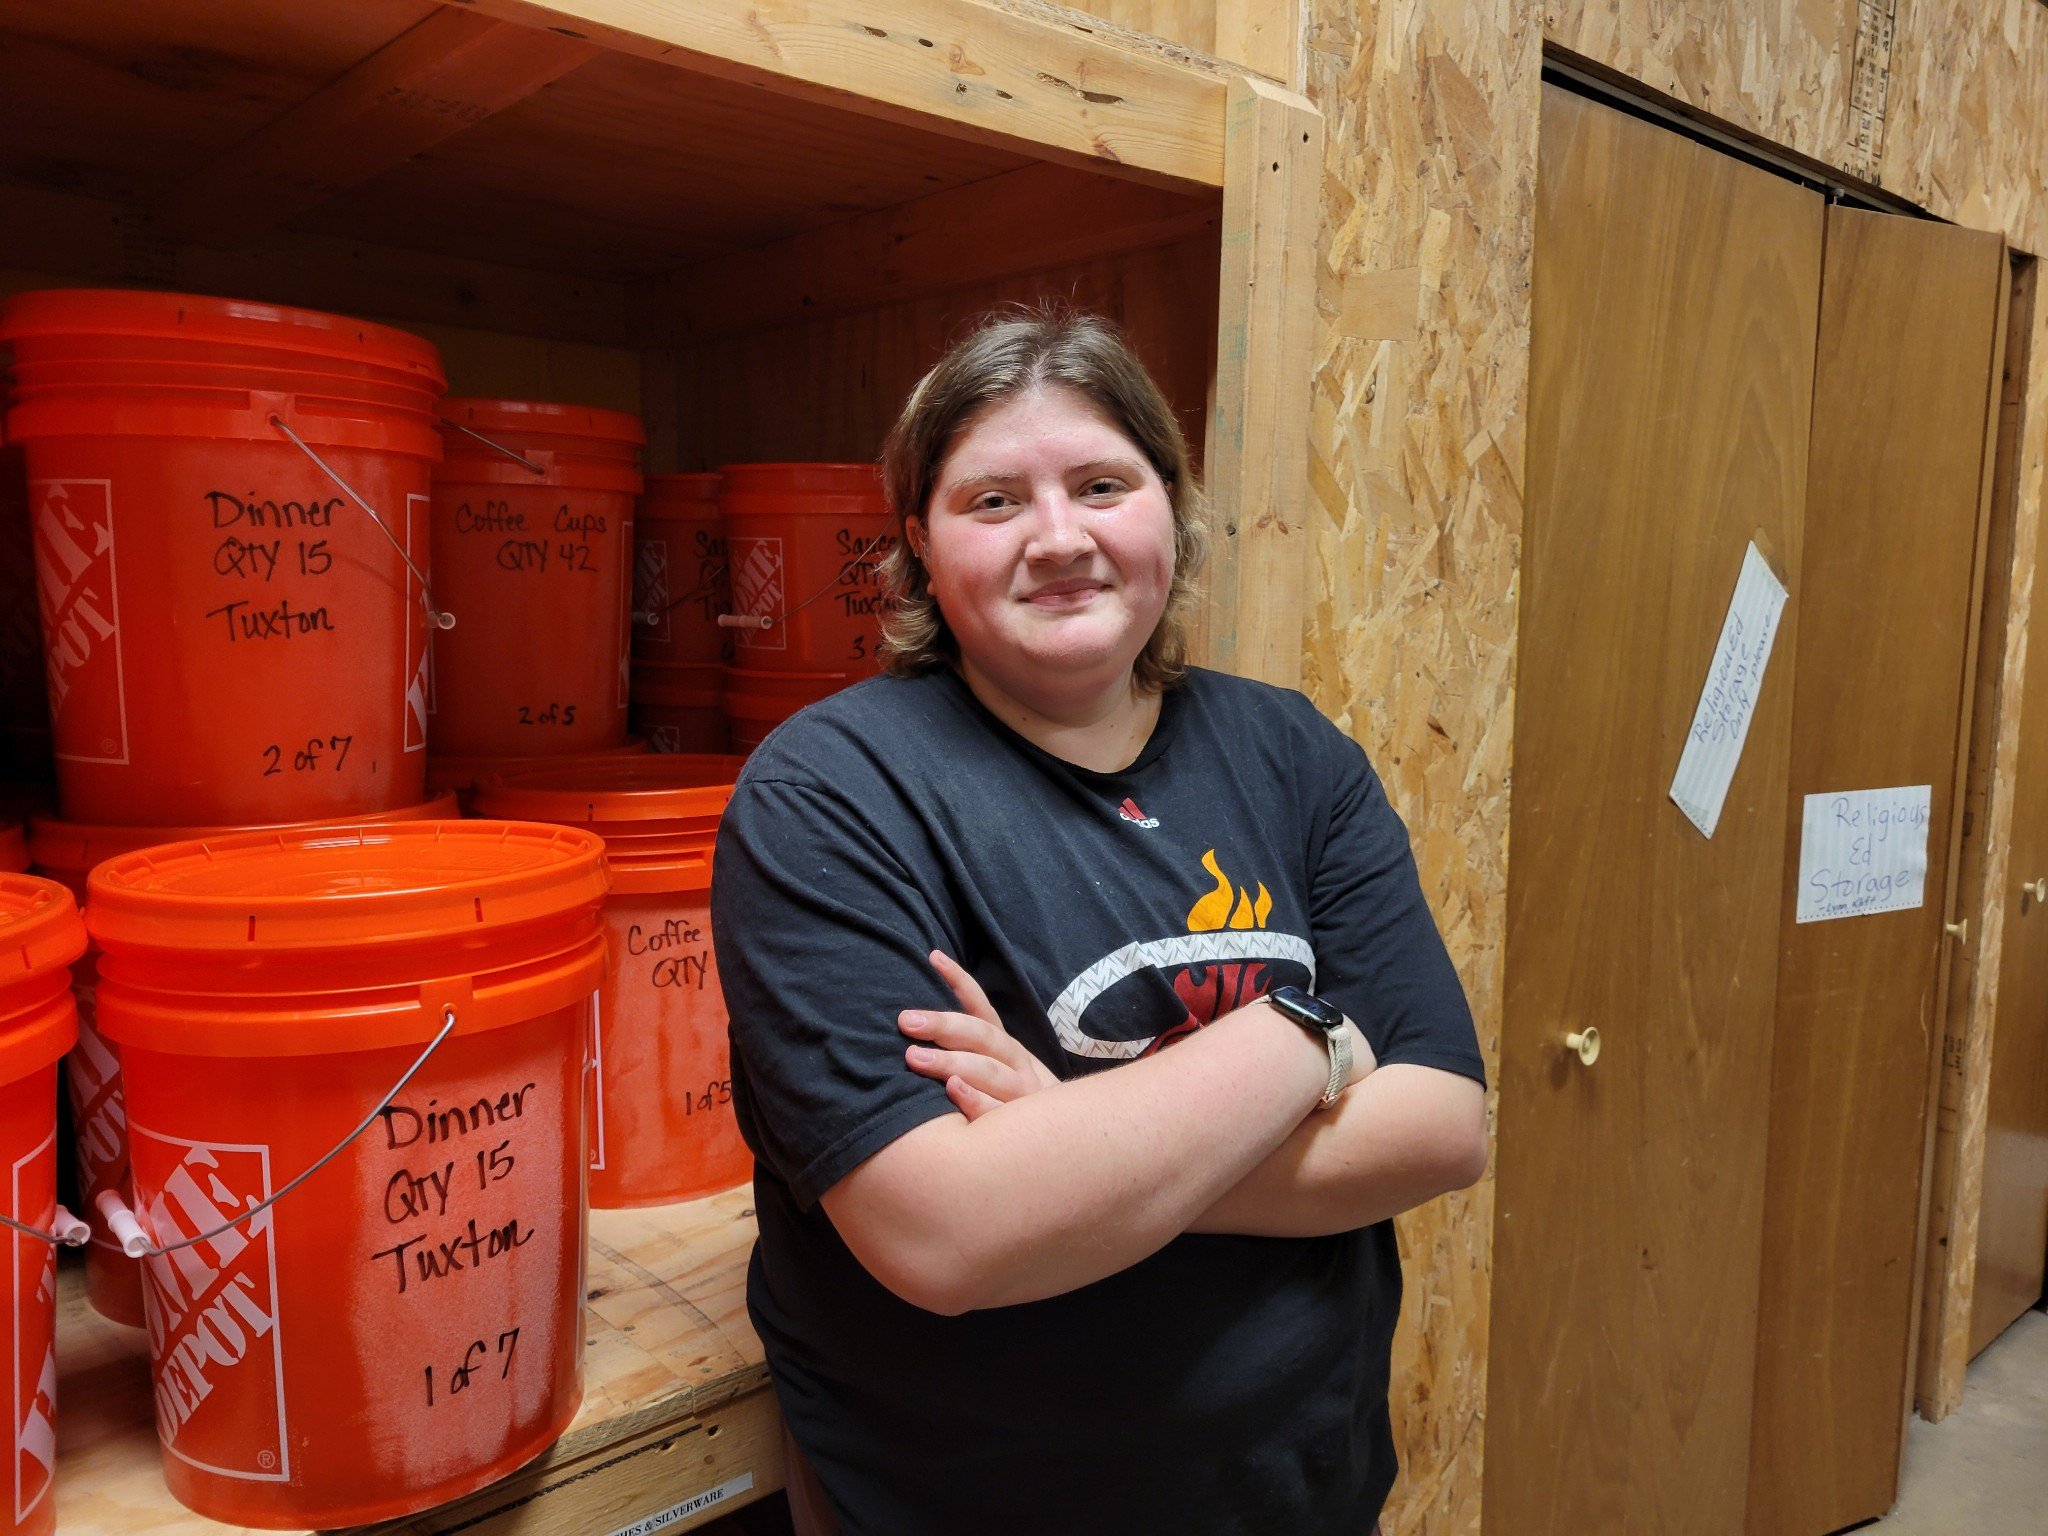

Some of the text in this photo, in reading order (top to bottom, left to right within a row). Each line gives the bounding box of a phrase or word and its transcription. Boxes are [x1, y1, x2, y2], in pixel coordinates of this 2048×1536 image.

[204, 491, 345, 528] Dinner
[456, 501, 607, 542] Coffee Cups
[299, 540, 333, 576] 15
[559, 544, 598, 572] 42
[205, 600, 335, 642] Tuxton
[1712, 643, 1749, 743] Storage
[518, 703, 577, 726] 2 of 5
[262, 735, 353, 777] 2 of 7
[1832, 797, 1928, 842] Religious
[1849, 833, 1872, 865] Ed
[1810, 868, 1910, 903] Storage
[627, 919, 702, 956] Coffee
[380, 1083, 536, 1150] Dinner
[685, 1080, 733, 1116] 1 of 5
[476, 1140, 515, 1190] 15
[370, 1219, 535, 1294] Tuxton
[425, 1327, 520, 1407] 1 of 7
[644, 1521, 653, 1531] &
[655, 1488, 724, 1528] SILVERWARE
